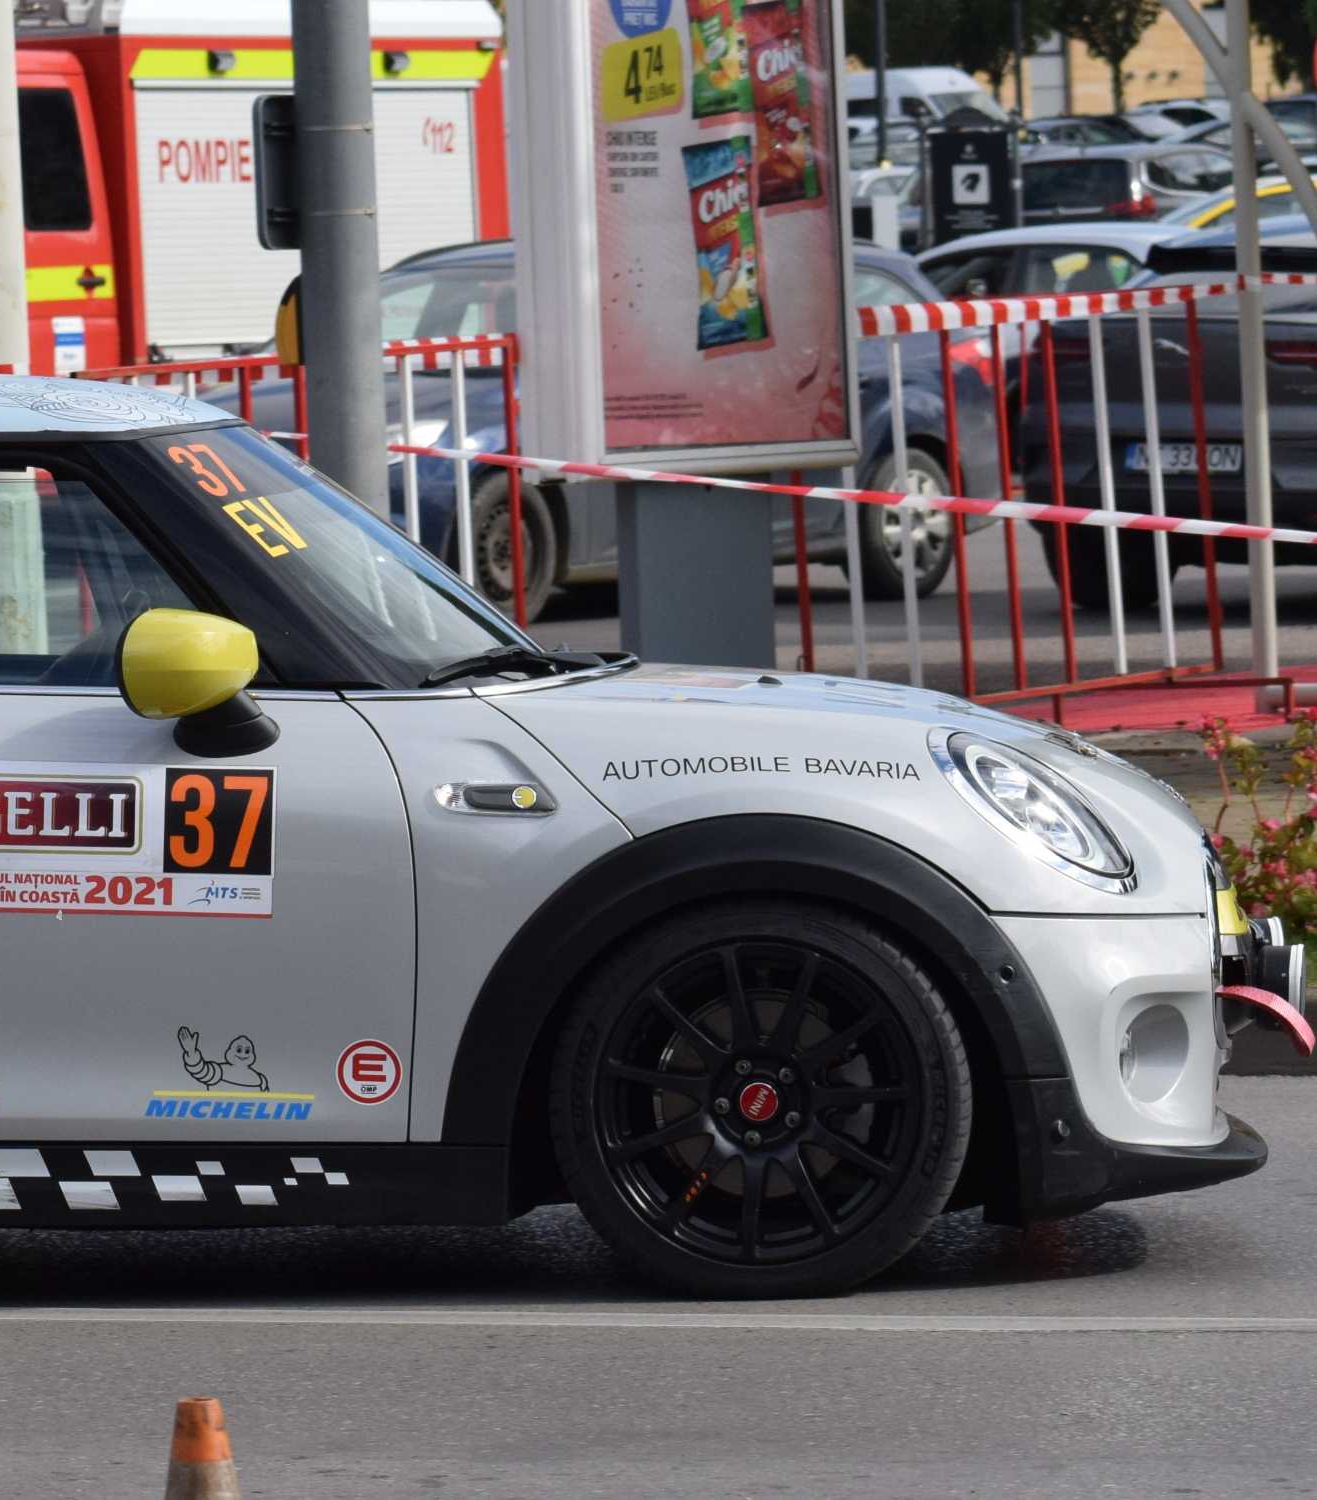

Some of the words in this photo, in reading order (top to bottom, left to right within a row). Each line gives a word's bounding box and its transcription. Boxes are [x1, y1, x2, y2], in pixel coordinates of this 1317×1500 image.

[430, 121, 455, 153] 112
[168, 444, 246, 498] 37
[221, 495, 307, 558] EV
[602, 755, 791, 781] AUTOMOBILE
[804, 757, 920, 781] BAVARIA
[168, 773, 270, 869] 37
[0, 885, 17, 903] ÎN
[19, 889, 81, 904] COASTĂ
[83, 874, 174, 906] 2021
[204, 886, 239, 899] MTS
[144, 1098, 315, 1121] MICHELIN
